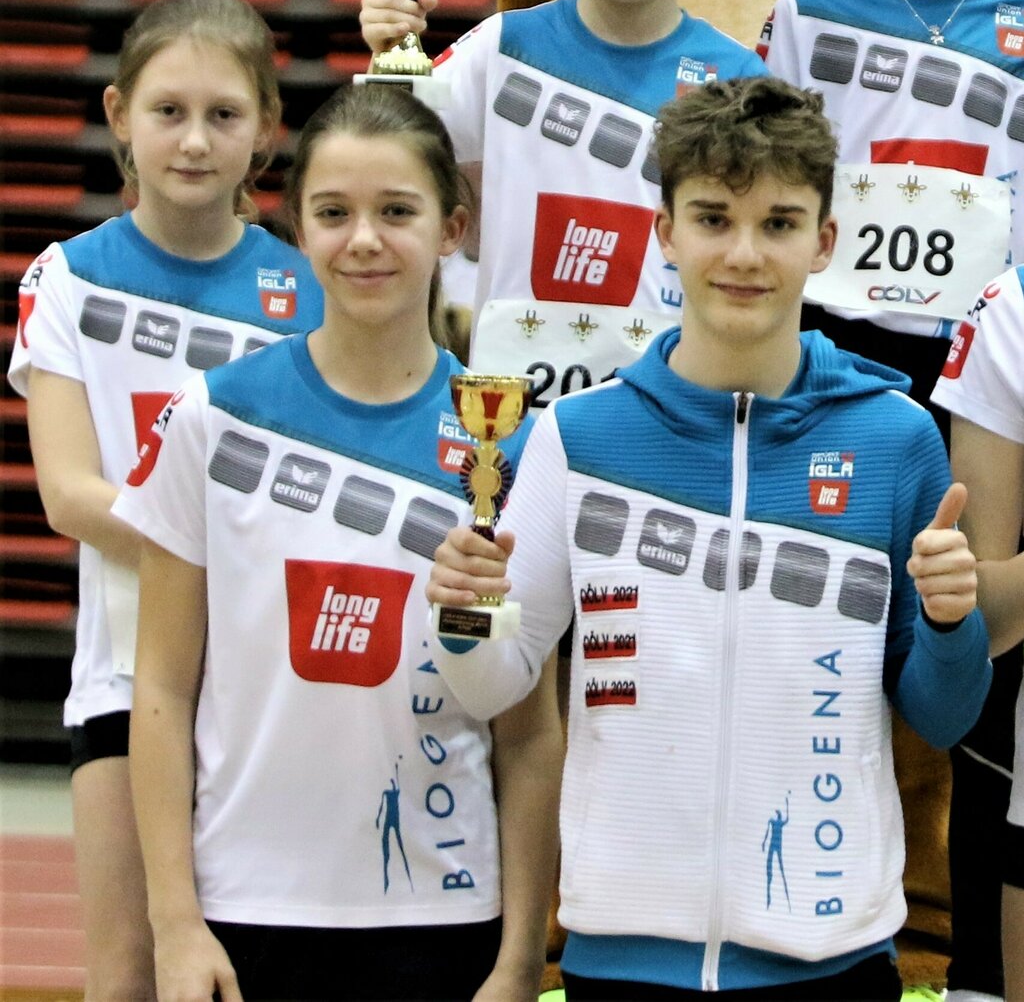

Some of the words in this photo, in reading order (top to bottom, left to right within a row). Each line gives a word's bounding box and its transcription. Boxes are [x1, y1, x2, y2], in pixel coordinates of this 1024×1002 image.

[863, 70, 900, 86] erima
[544, 118, 579, 140] erima
[563, 218, 619, 257] long
[854, 223, 956, 277] 208
[552, 244, 609, 286] life
[135, 334, 174, 352] erima
[525, 361, 622, 409] 20
[274, 482, 320, 505] erima
[640, 543, 687, 568] erima
[320, 585, 381, 624] long
[310, 613, 371, 654] life
[412, 640, 475, 891] BIOGE
[812, 649, 844, 917] BIOGENA
